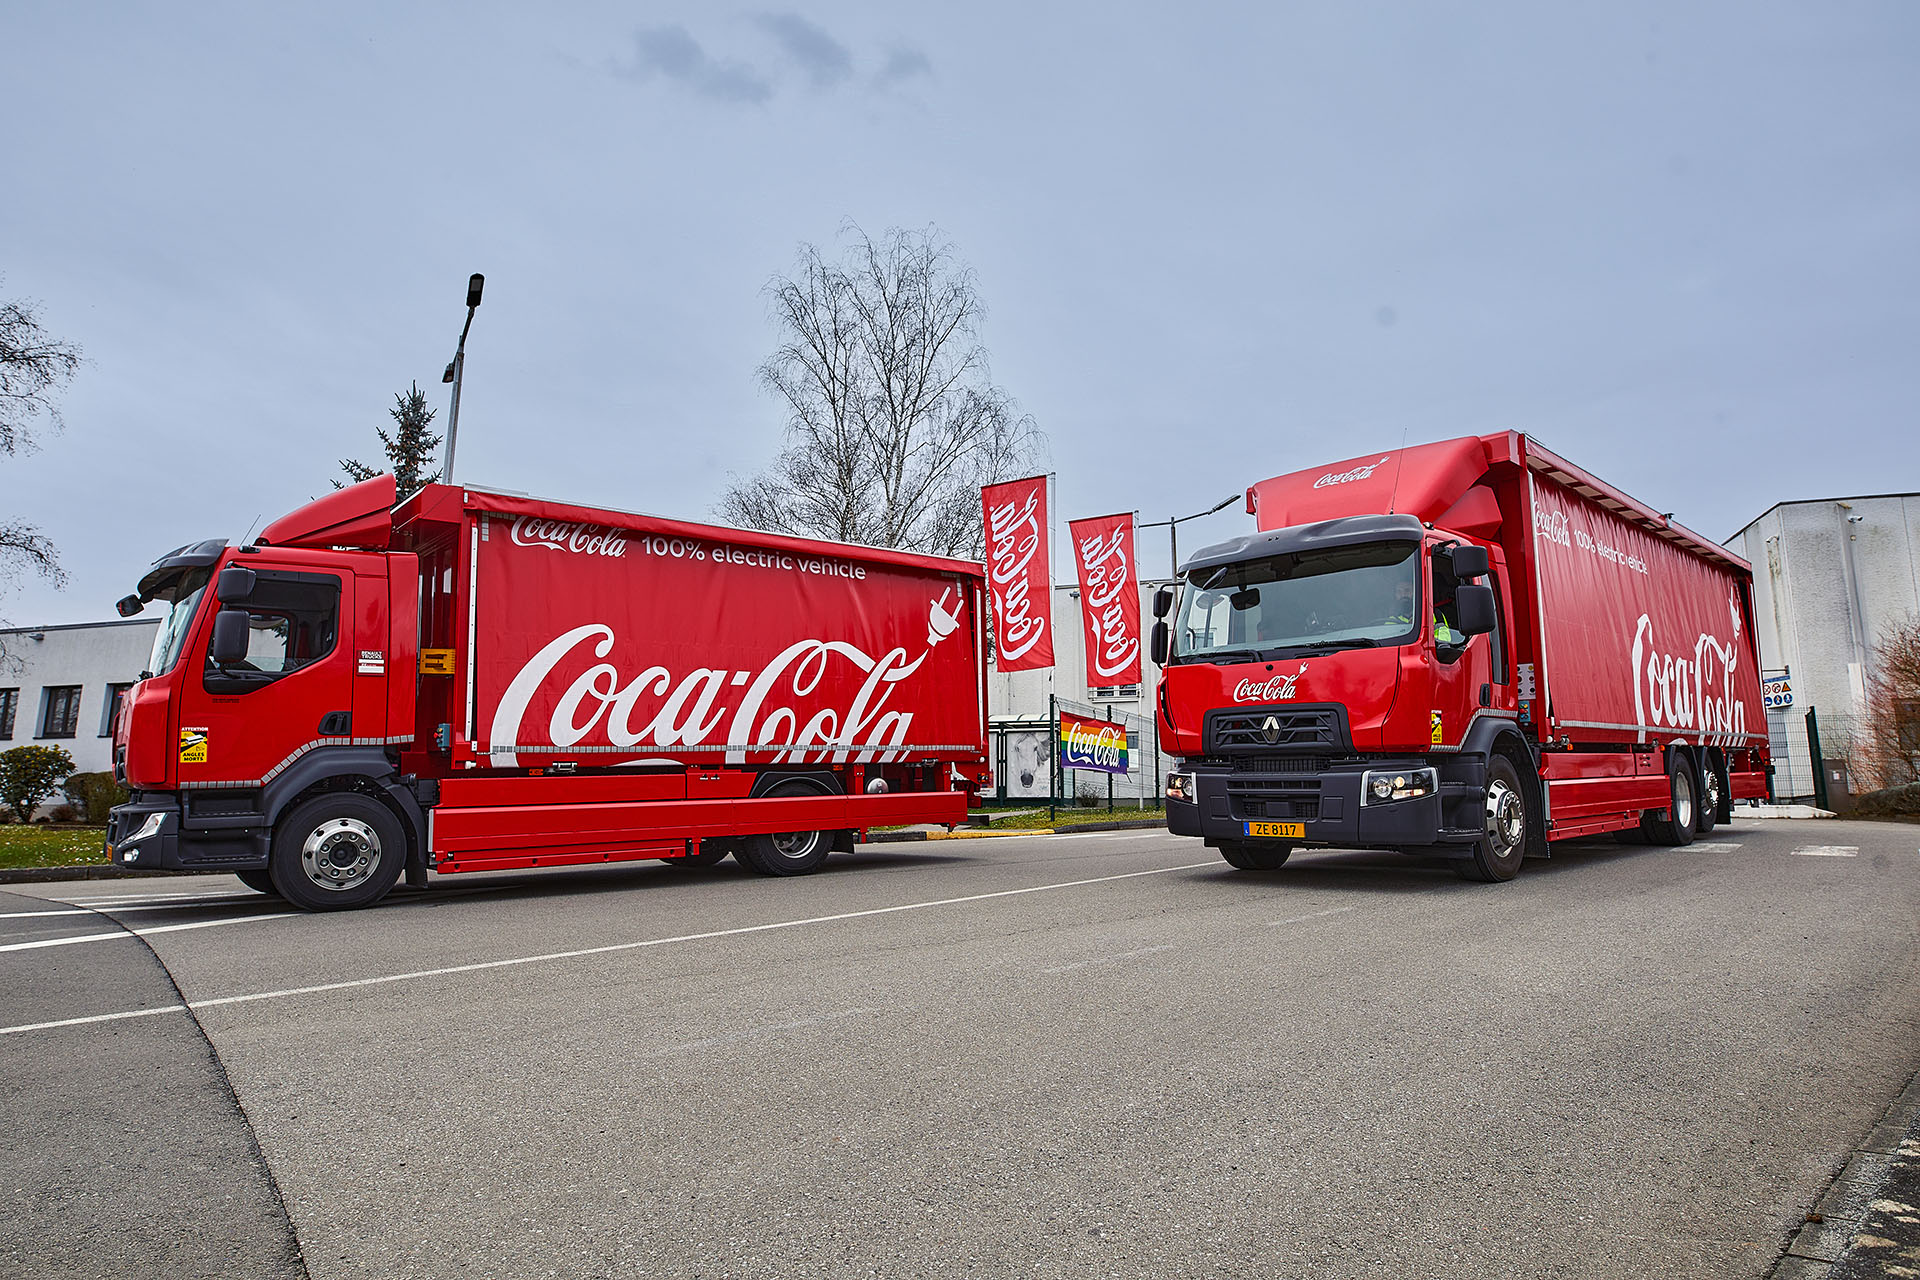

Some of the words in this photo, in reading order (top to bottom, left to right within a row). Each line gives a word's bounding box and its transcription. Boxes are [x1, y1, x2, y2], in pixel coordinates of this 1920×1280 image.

[1313, 465, 1378, 488] Coca-Cola
[511, 516, 626, 558] Coca-Cola
[641, 535, 706, 561] 100%
[712, 545, 792, 571] electric
[797, 556, 867, 580] vehicle
[1574, 529, 1596, 553] 100%
[991, 488, 1044, 660] Coca-Cola
[1081, 523, 1139, 677] Coca-Cola
[490, 623, 928, 766] Coca-Cola
[1233, 674, 1299, 702] Coca-Cola
[1632, 613, 1748, 747] Coca-Cola
[1067, 722, 1121, 767] Coca-Cola
[1256, 824, 1269, 835] ZE
[1271, 824, 1296, 836] 8117
